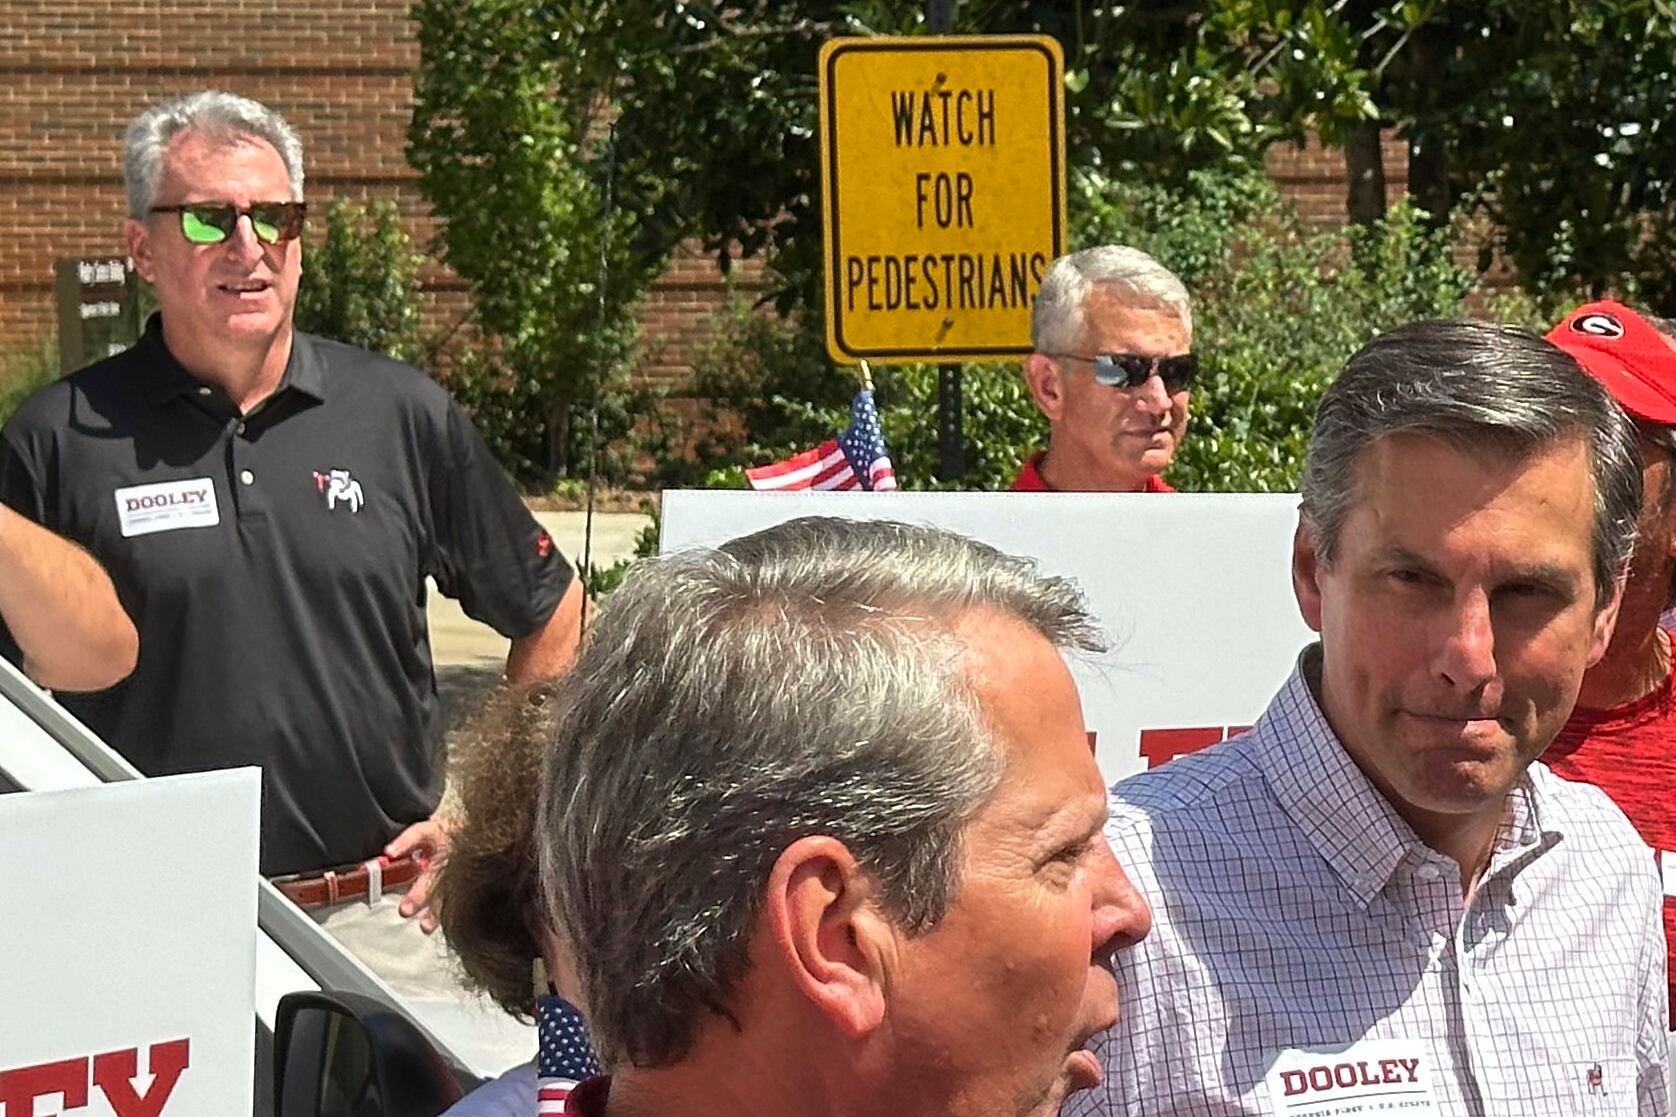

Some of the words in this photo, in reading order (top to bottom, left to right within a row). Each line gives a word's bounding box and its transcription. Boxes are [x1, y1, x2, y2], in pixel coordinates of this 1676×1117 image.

[891, 90, 996, 147] WATCH
[916, 172, 974, 229] FOR
[848, 252, 1046, 311] PEDESTRIANS
[126, 489, 208, 513] DOOLEY
[1279, 1058, 1420, 1097] DOOLEY
